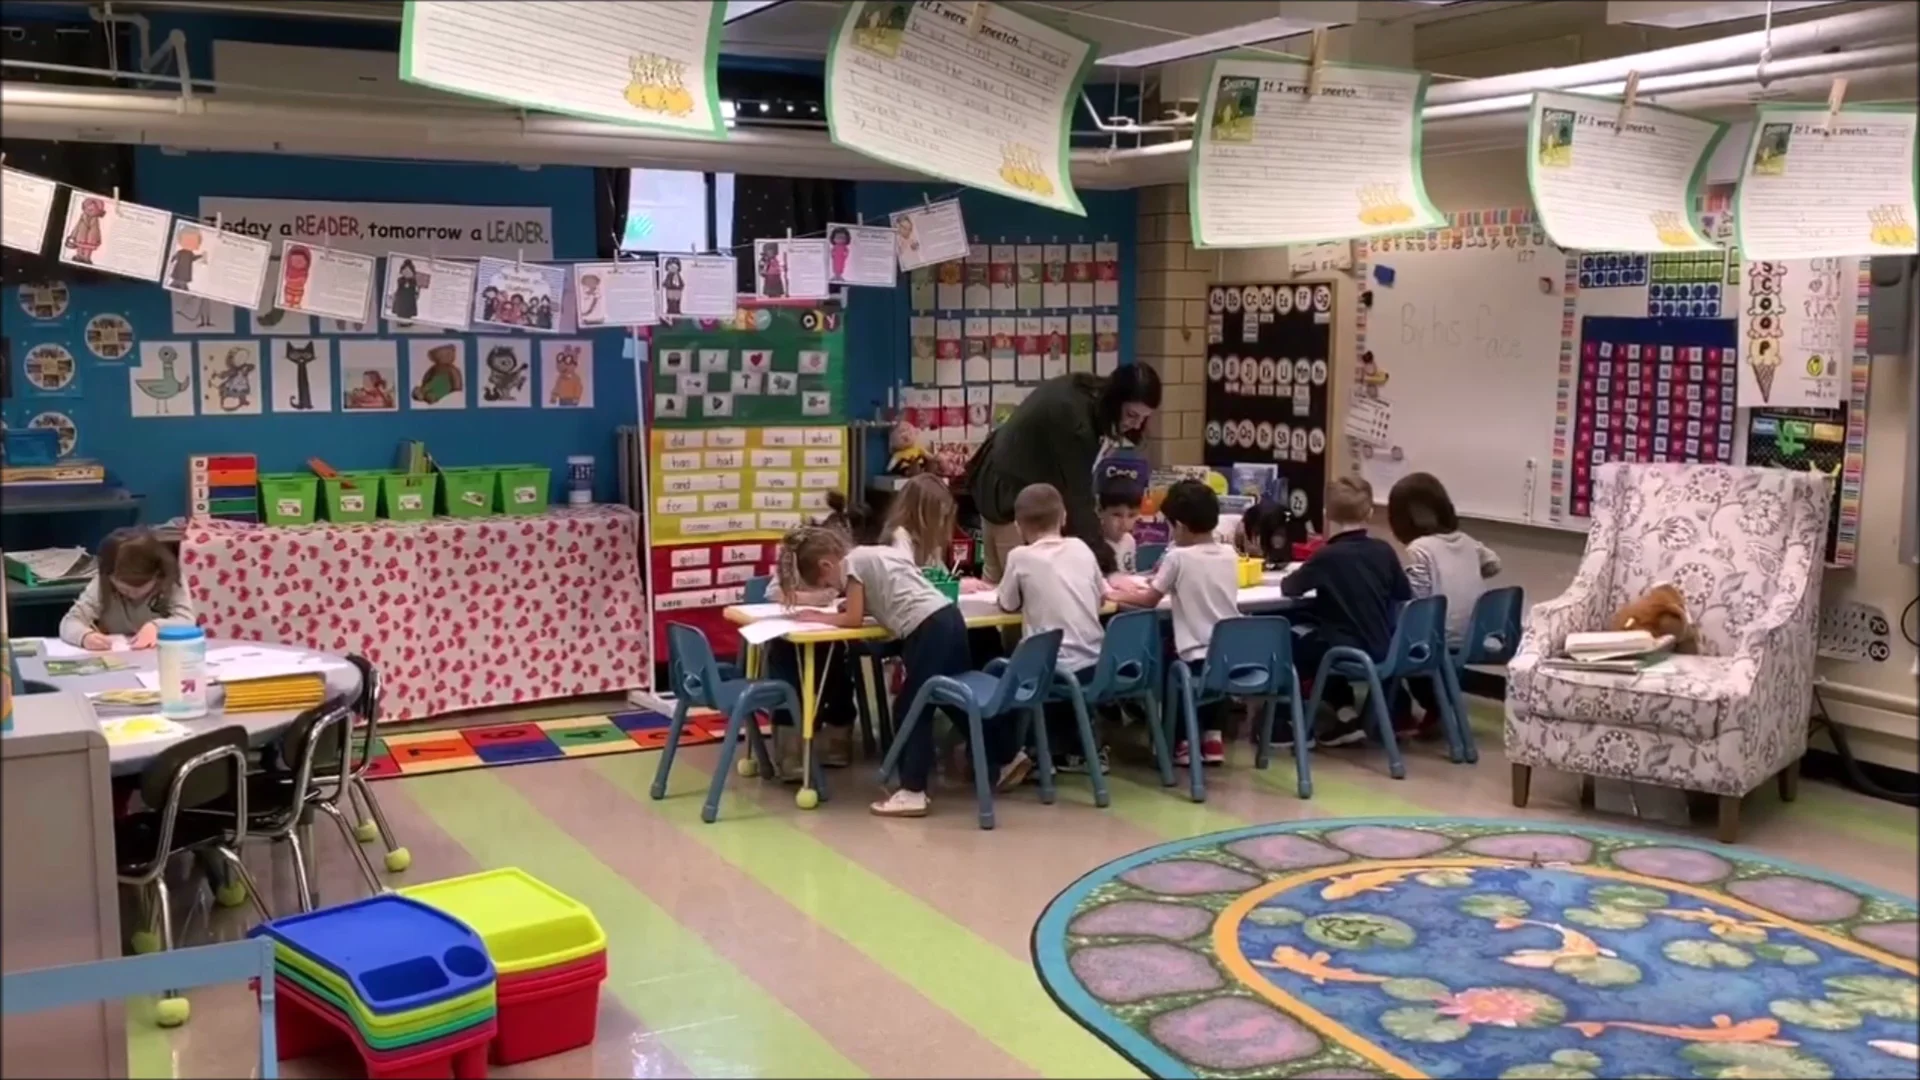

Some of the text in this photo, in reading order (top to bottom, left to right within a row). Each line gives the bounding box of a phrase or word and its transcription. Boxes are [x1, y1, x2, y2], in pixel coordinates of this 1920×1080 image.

[1263, 81, 1273, 92] If
[1277, 82, 1284, 93] I
[279, 222, 293, 238] a
[295, 215, 365, 240] READER,
[368, 221, 462, 241] tomorrow
[470, 226, 483, 242] a
[487, 219, 550, 245] LEADER.
[730, 549, 746, 560] be
